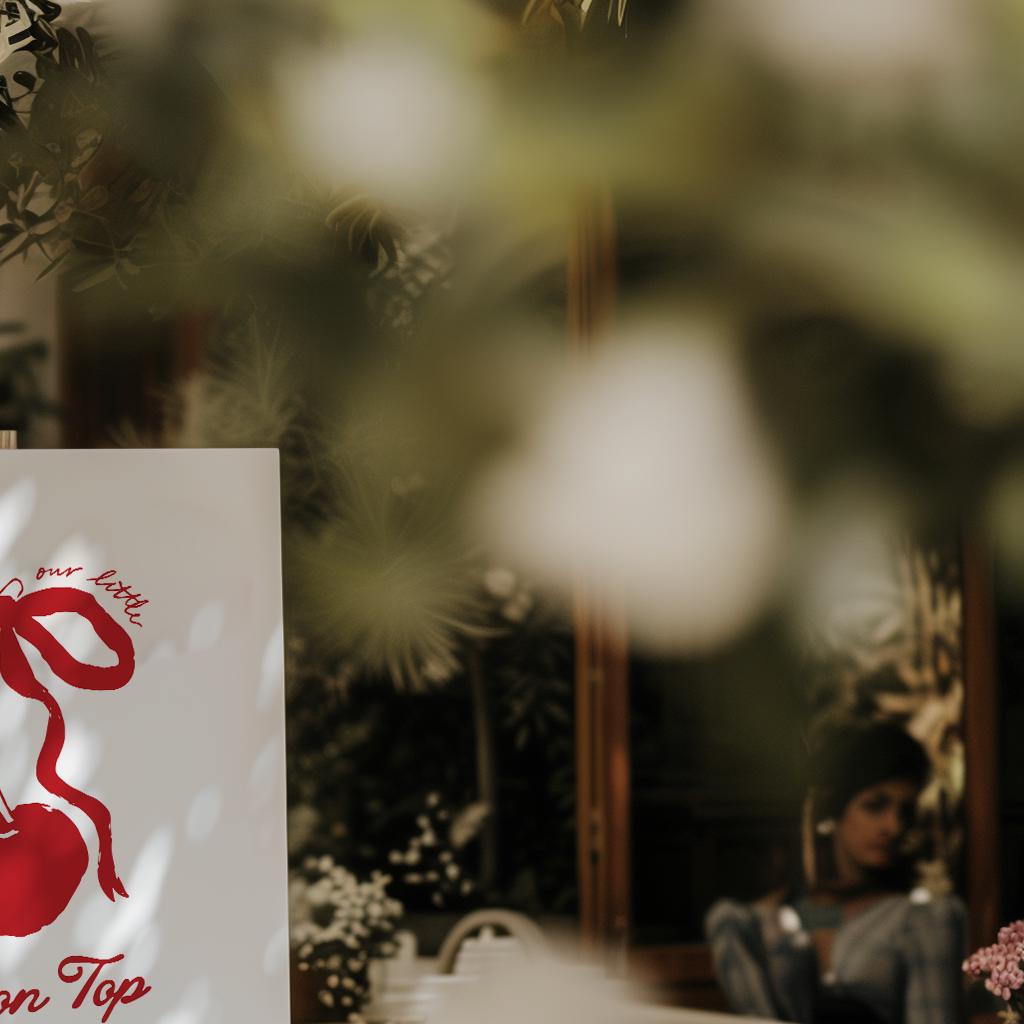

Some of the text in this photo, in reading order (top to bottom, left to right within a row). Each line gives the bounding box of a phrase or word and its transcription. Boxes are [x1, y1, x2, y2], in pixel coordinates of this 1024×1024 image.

[35, 565, 83, 581] our
[86, 569, 149, 628] little
[57, 953, 152, 1024] Top
